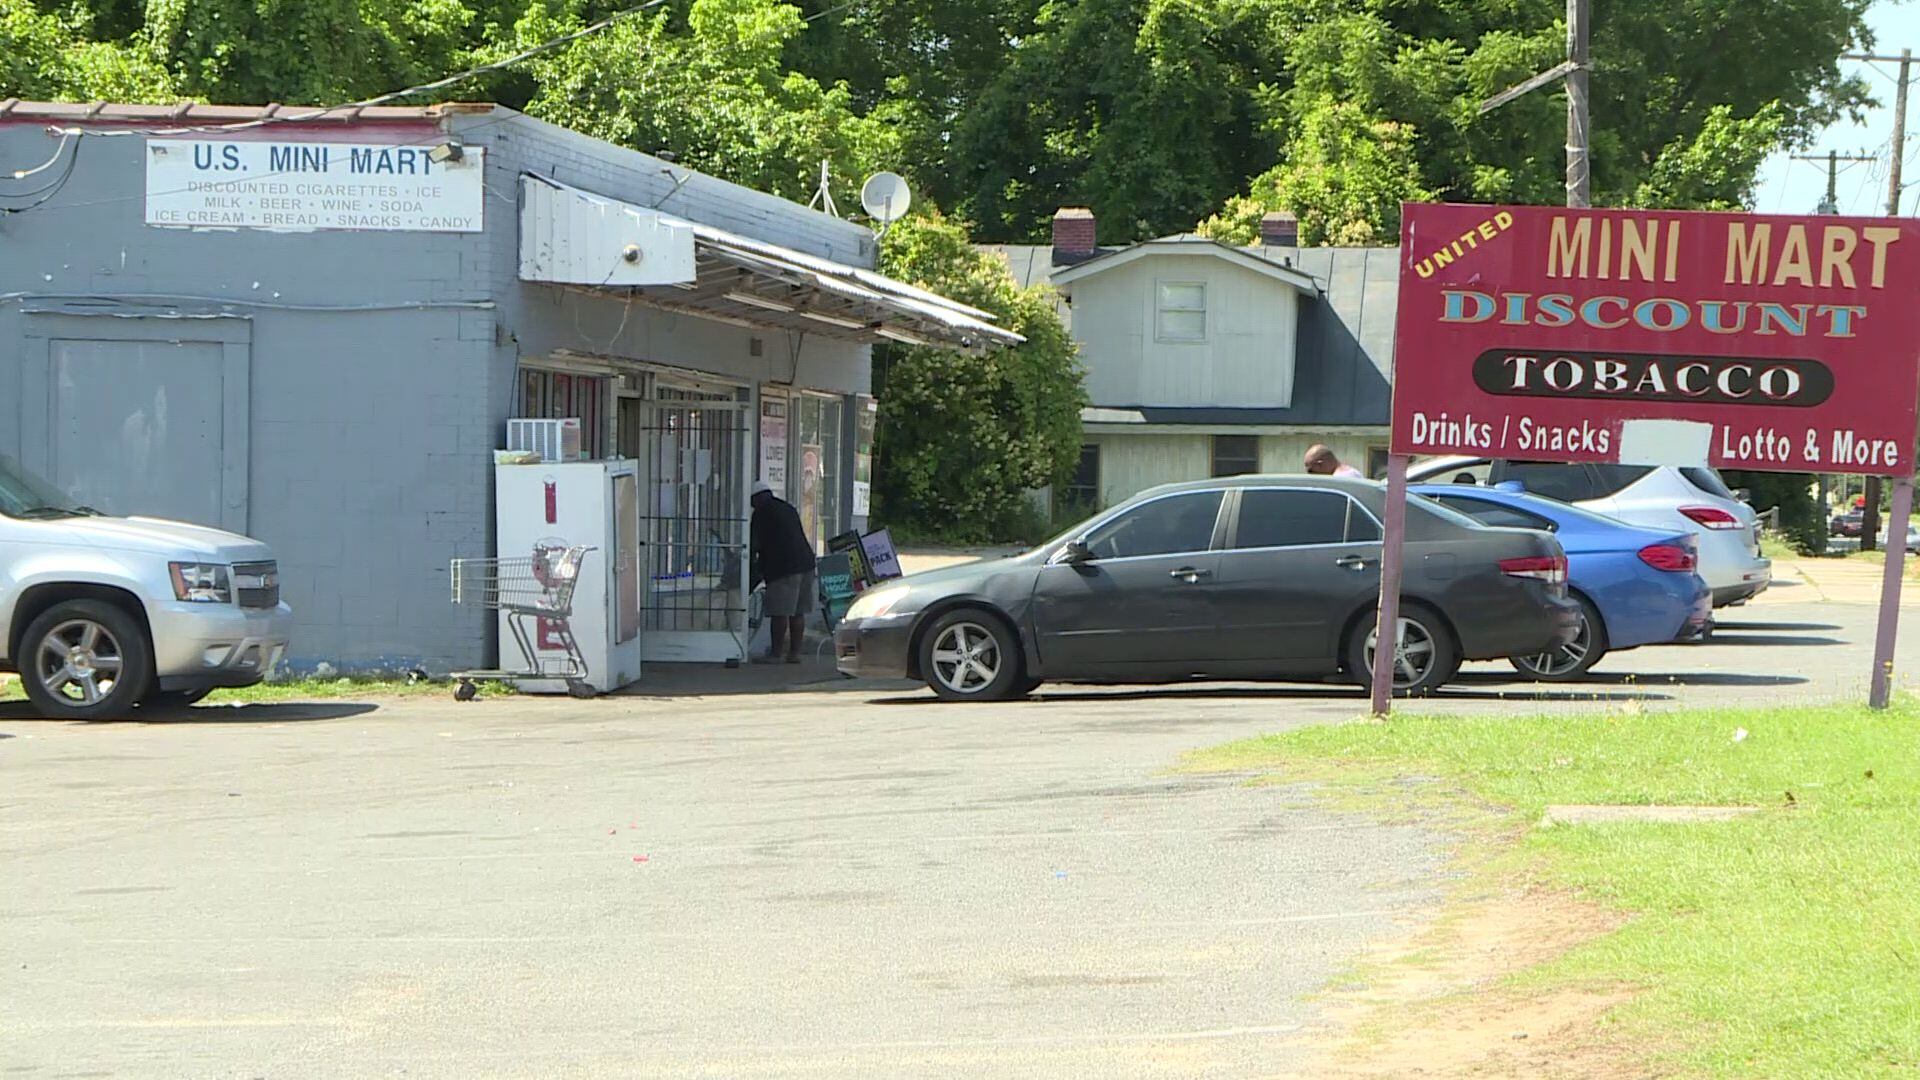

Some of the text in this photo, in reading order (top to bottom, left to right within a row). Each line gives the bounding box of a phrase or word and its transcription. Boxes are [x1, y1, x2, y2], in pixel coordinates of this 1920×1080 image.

[194, 144, 432, 175] U.S. MINI MART
[188, 181, 441, 197] DISCOUNTED CIGARETTES ICE
[204, 197, 423, 212] MILK BEER WINE SODA
[155, 210, 473, 228] ICE CREAM BREAD SNACKS CANDY
[1414, 210, 1514, 279] UNITED
[1546, 216, 1901, 289] MINI MART
[1438, 289, 1868, 338] DISCOUNT
[1503, 355, 1802, 400] TOBACCO
[1412, 412, 1492, 448] Drinks
[1518, 416, 1611, 454] Snacks
[1722, 426, 1899, 467] Lotto & More
